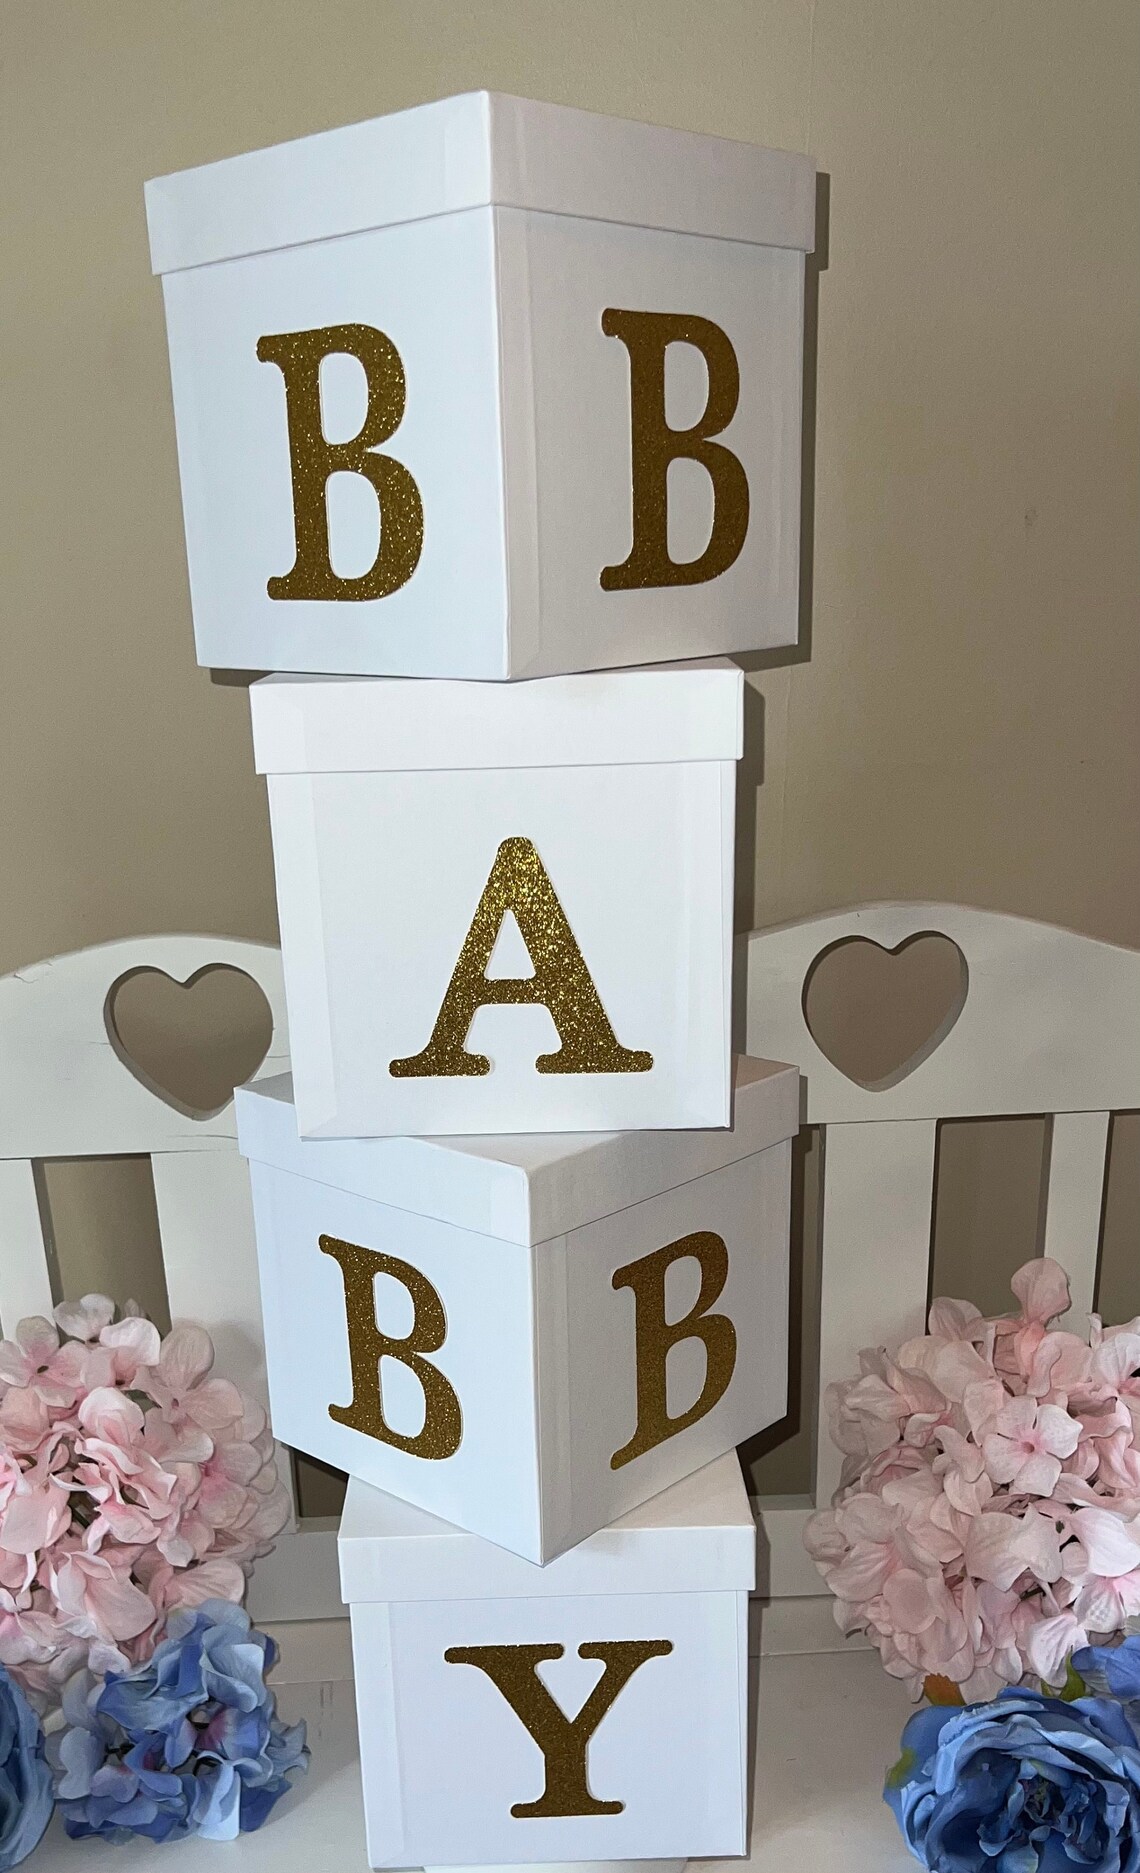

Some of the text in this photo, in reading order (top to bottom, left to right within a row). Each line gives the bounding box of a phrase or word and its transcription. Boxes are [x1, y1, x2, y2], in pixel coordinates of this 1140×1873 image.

[257, 324, 424, 600] B
[600, 309, 750, 590] B
[390, 837, 654, 1077] A
[319, 1235, 462, 1459] B
[611, 1231, 737, 1470] B
[445, 1641, 673, 1818] Y
